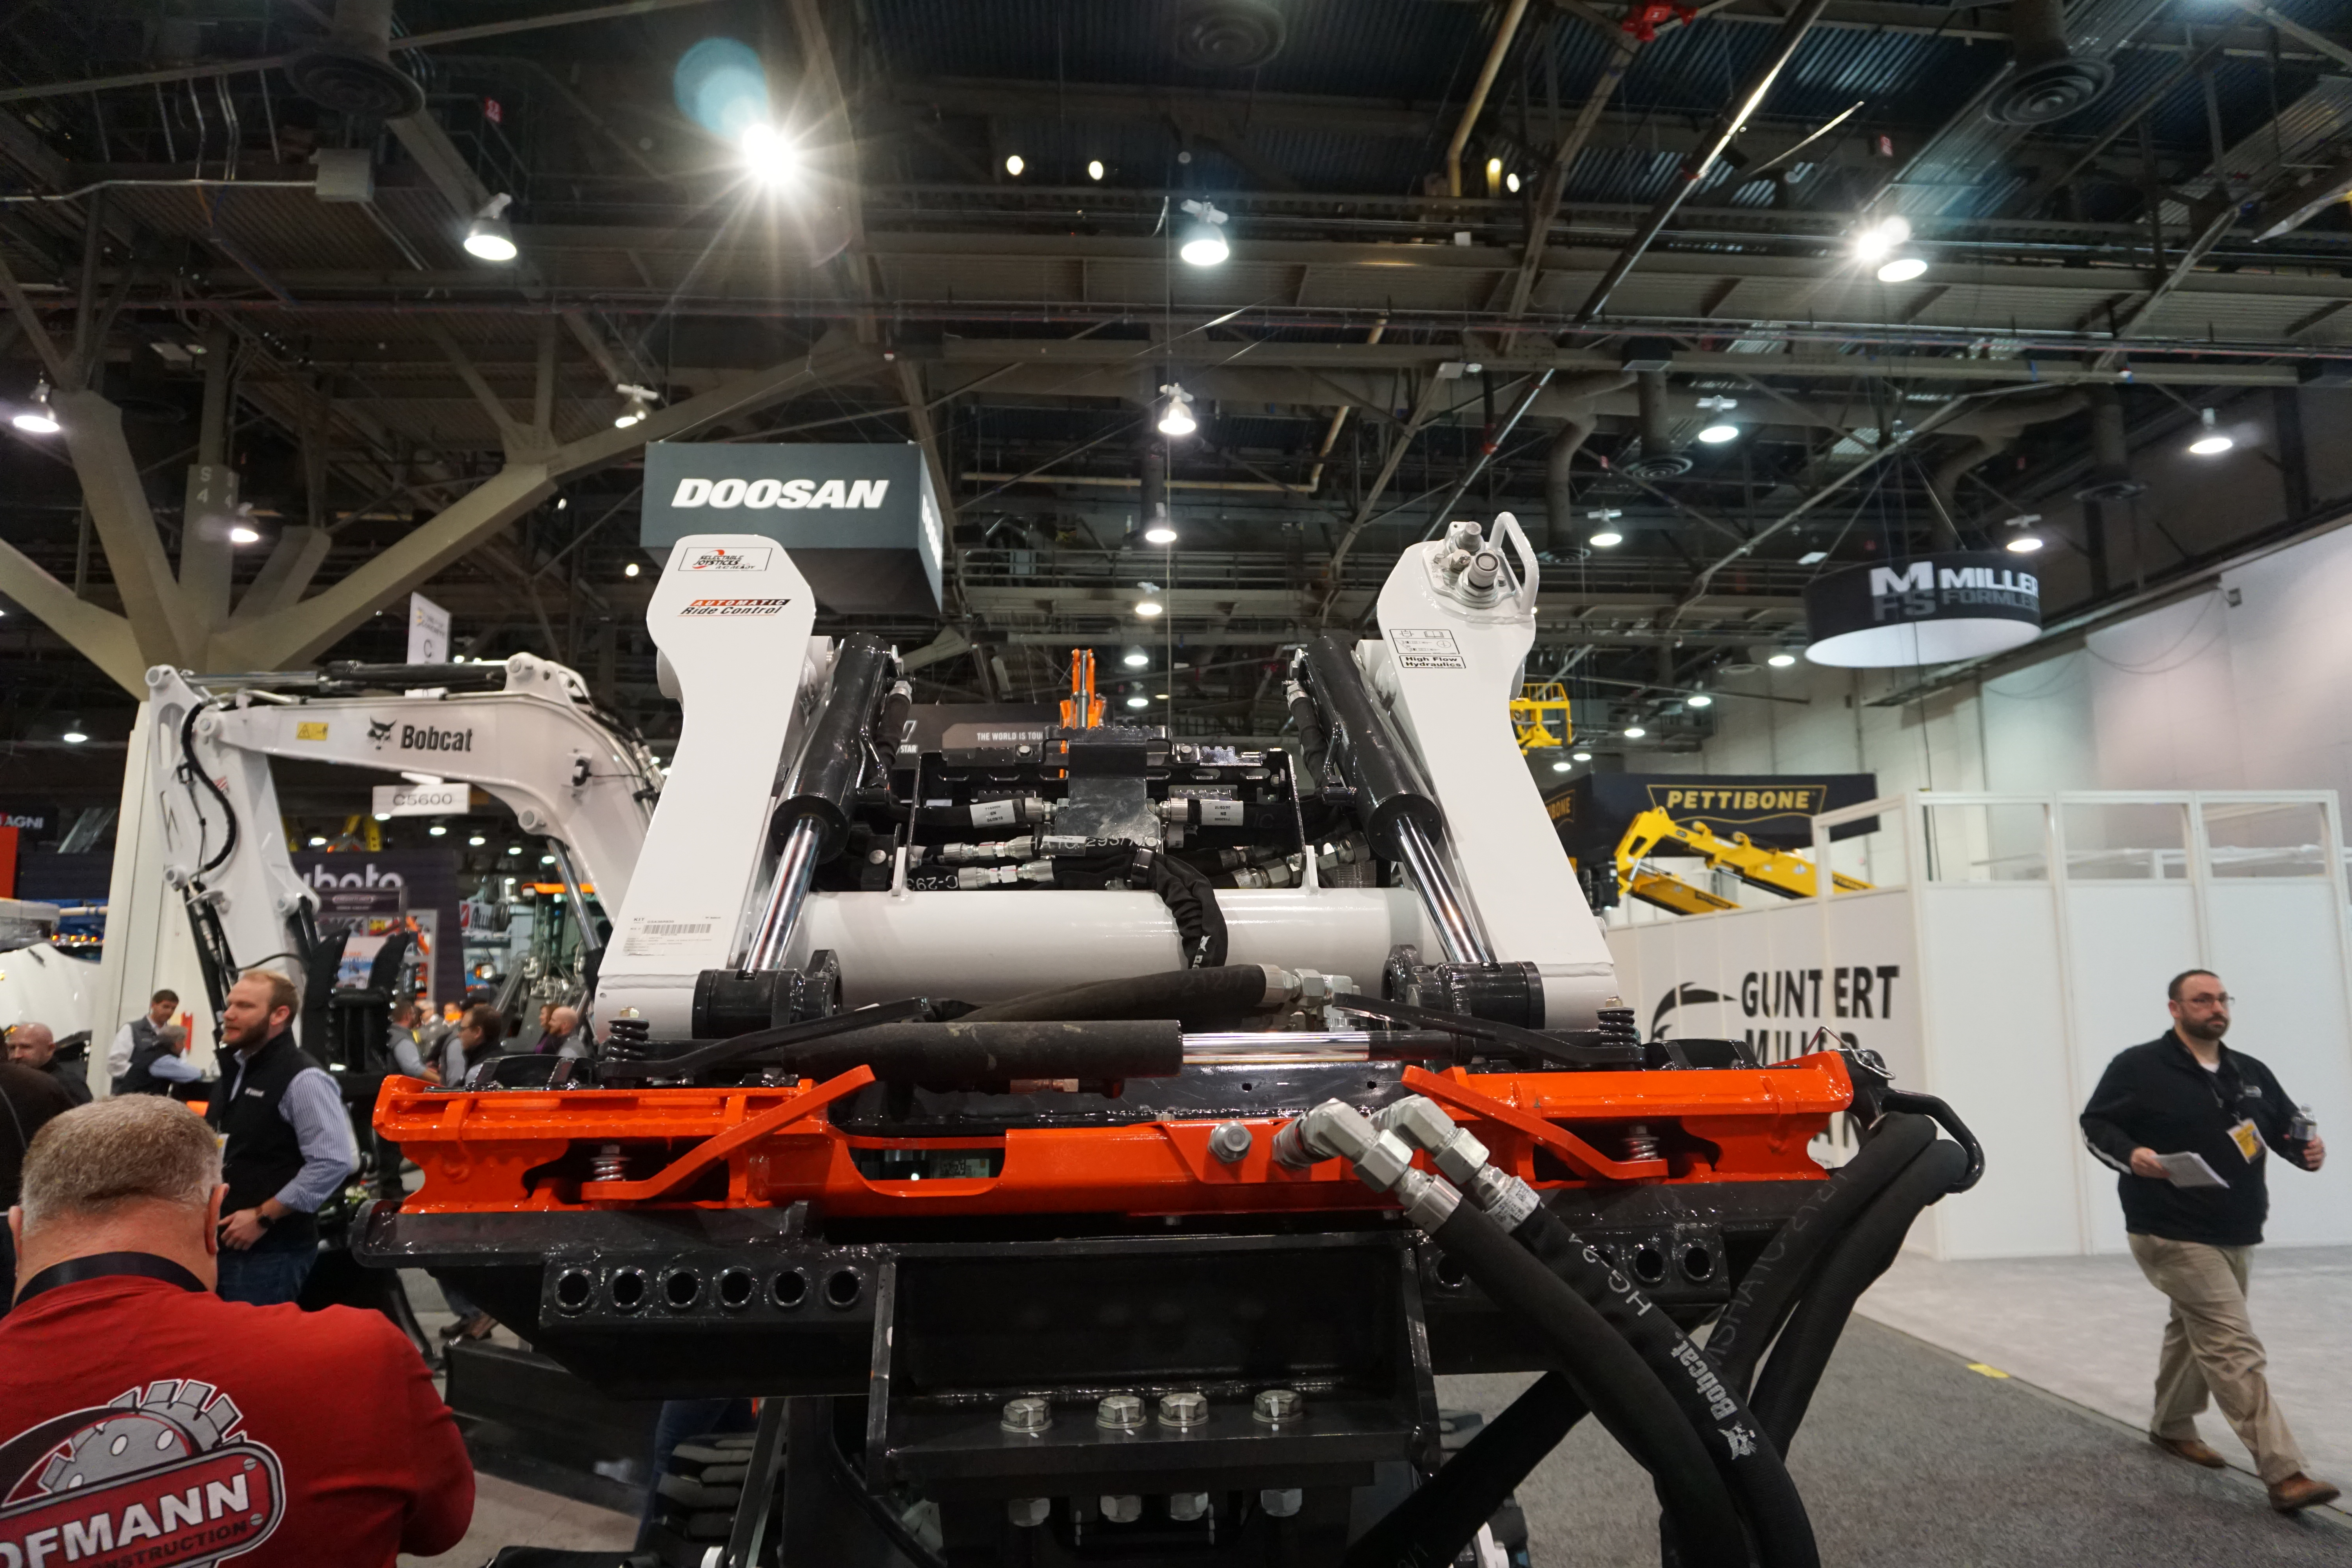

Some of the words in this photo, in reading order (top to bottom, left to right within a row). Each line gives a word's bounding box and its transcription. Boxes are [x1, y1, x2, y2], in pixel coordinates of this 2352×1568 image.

[671, 479, 889, 509] DOOSAN
[400, 725, 472, 751] Bobcat
[992, 732, 1016, 740] WORLD
[1028, 731, 1043, 740] TOU
[393, 794, 452, 806] C5600
[1666, 791, 1809, 809] PETTIBONE
[1671, 1341, 1738, 1421] Bobcat
